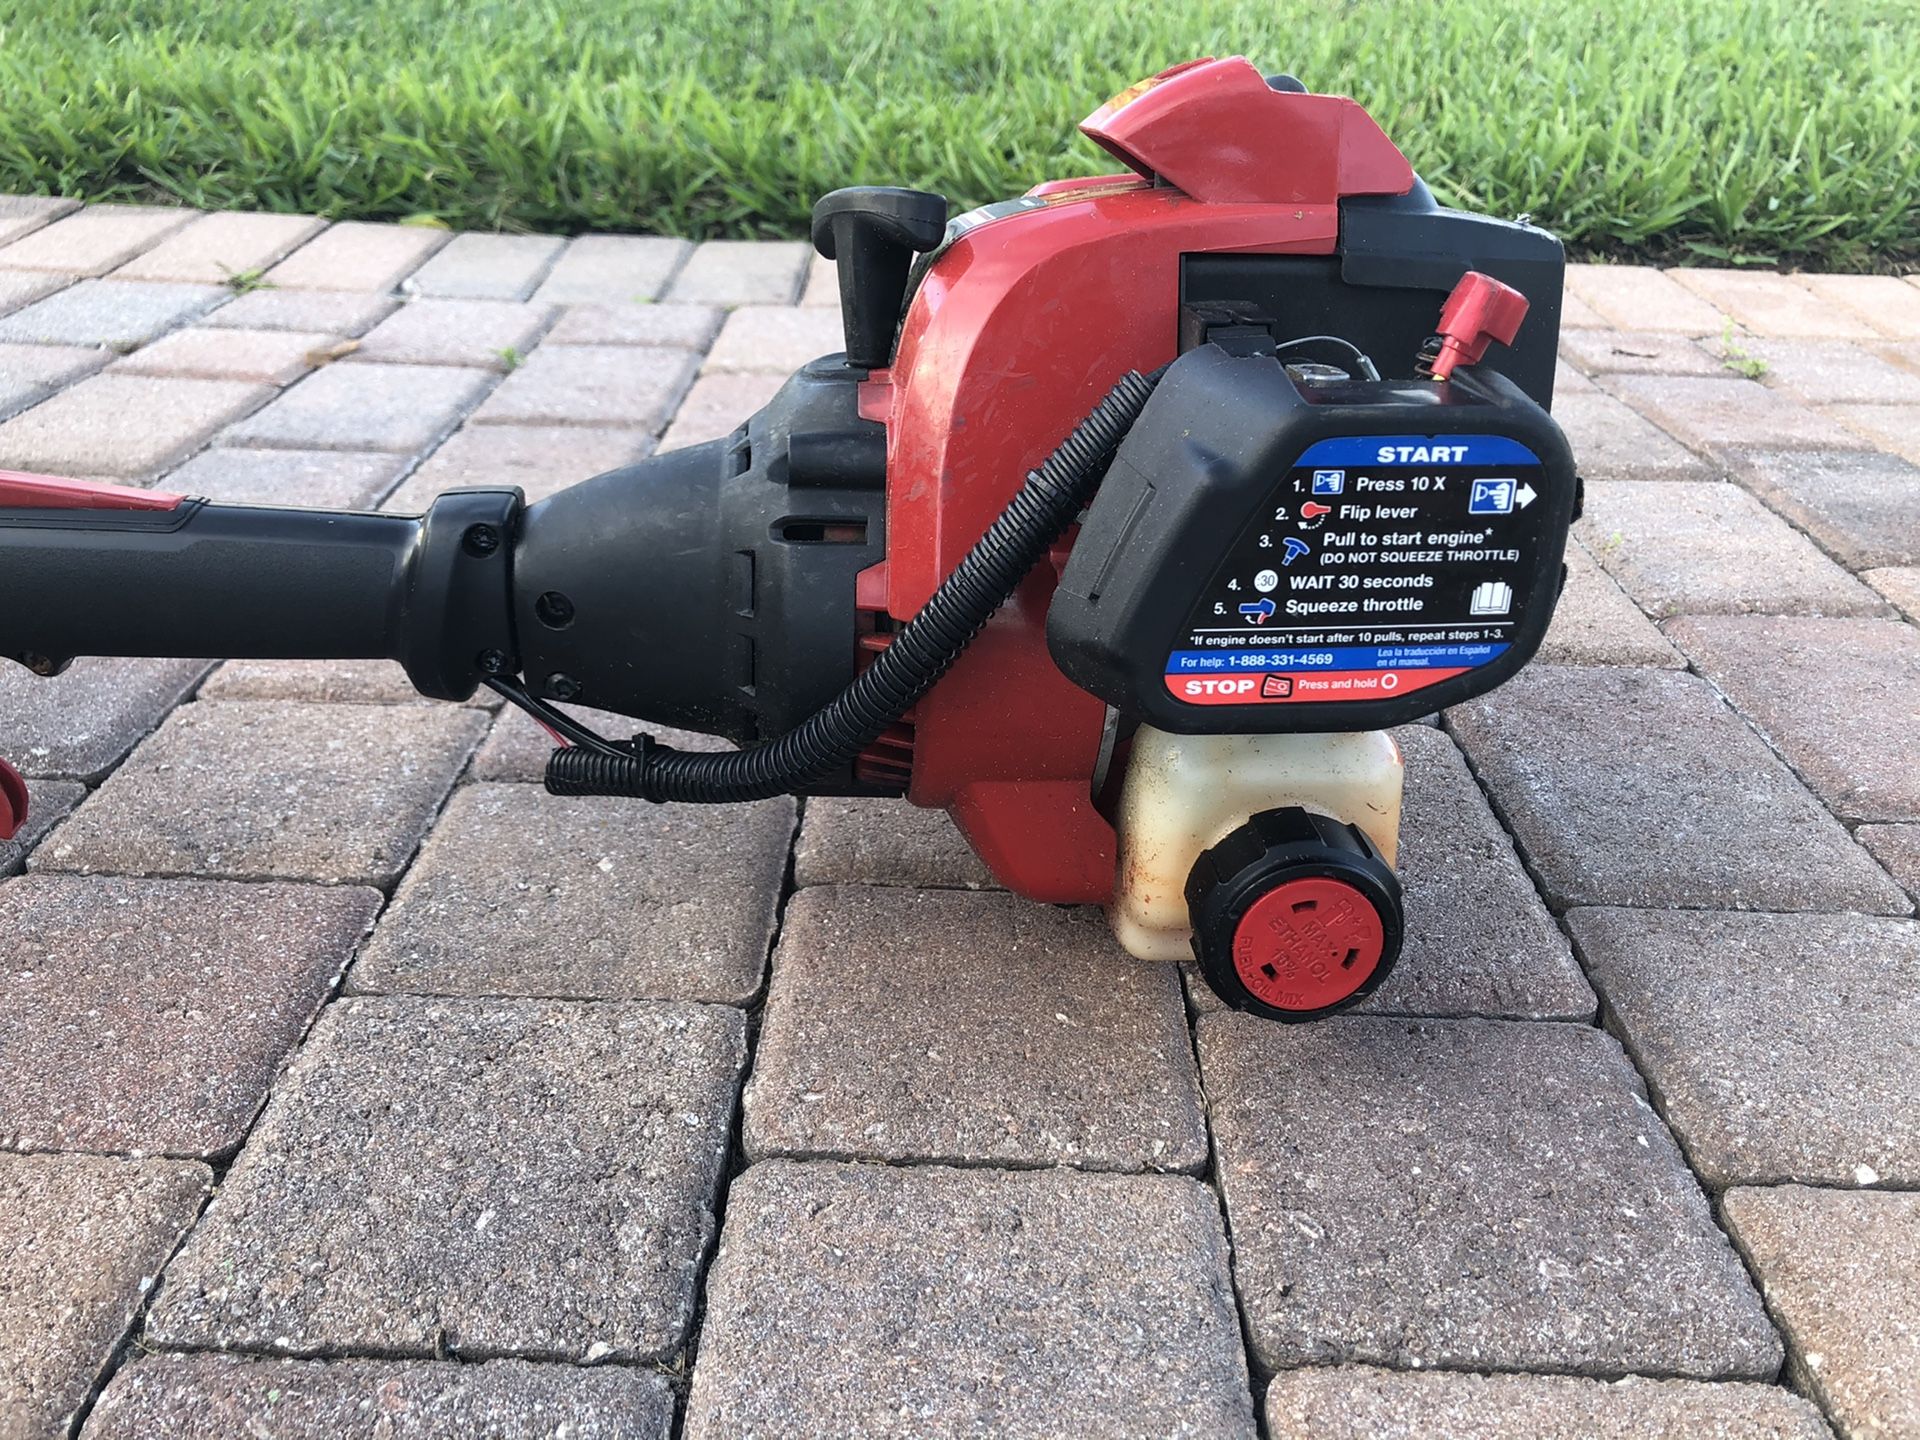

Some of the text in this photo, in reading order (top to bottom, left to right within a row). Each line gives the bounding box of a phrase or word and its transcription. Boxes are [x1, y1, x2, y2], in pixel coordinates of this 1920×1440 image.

[1377, 446, 1468, 463] START
[1293, 476, 1446, 492] 1. Press 10 X
[1275, 504, 1418, 521] 2. Flip lever
[1259, 535, 1273, 547] 3.
[1323, 532, 1355, 546] Pull
[1360, 532, 1377, 546] to
[1382, 531, 1421, 545] start
[1320, 550, 1520, 566] (DO NOT SQUEEZE THROTTLE)
[1228, 579, 1241, 590] 4.
[1290, 575, 1335, 590] WAIT
[1338, 575, 1359, 589] 30
[1363, 574, 1434, 588] seconds
[1214, 598, 1423, 615] 5. Squeeze throttle
[1205, 635, 1245, 647] engine
[1249, 634, 1293, 645] doesn't
[1296, 634, 1324, 644] start
[1326, 633, 1354, 643] after
[1358, 632, 1371, 642] 10
[1374, 632, 1405, 643] pulls,
[1408, 630, 1445, 642] repeat
[1448, 629, 1479, 641] steps
[1483, 629, 1504, 639] 1-3.
[1378, 648, 1393, 656] Lea
[1394, 648, 1402, 656] la
[1403, 647, 1446, 656] traducción
[1459, 646, 1491, 656] Español
[1181, 654, 1333, 668] For help: 1-888-331-4569
[1376, 658, 1430, 667] en el manual.
[1185, 678, 1377, 694] STOP Press and hold
[1268, 917, 1333, 984] ETHANOL
[1275, 990, 1305, 1006] MIX
